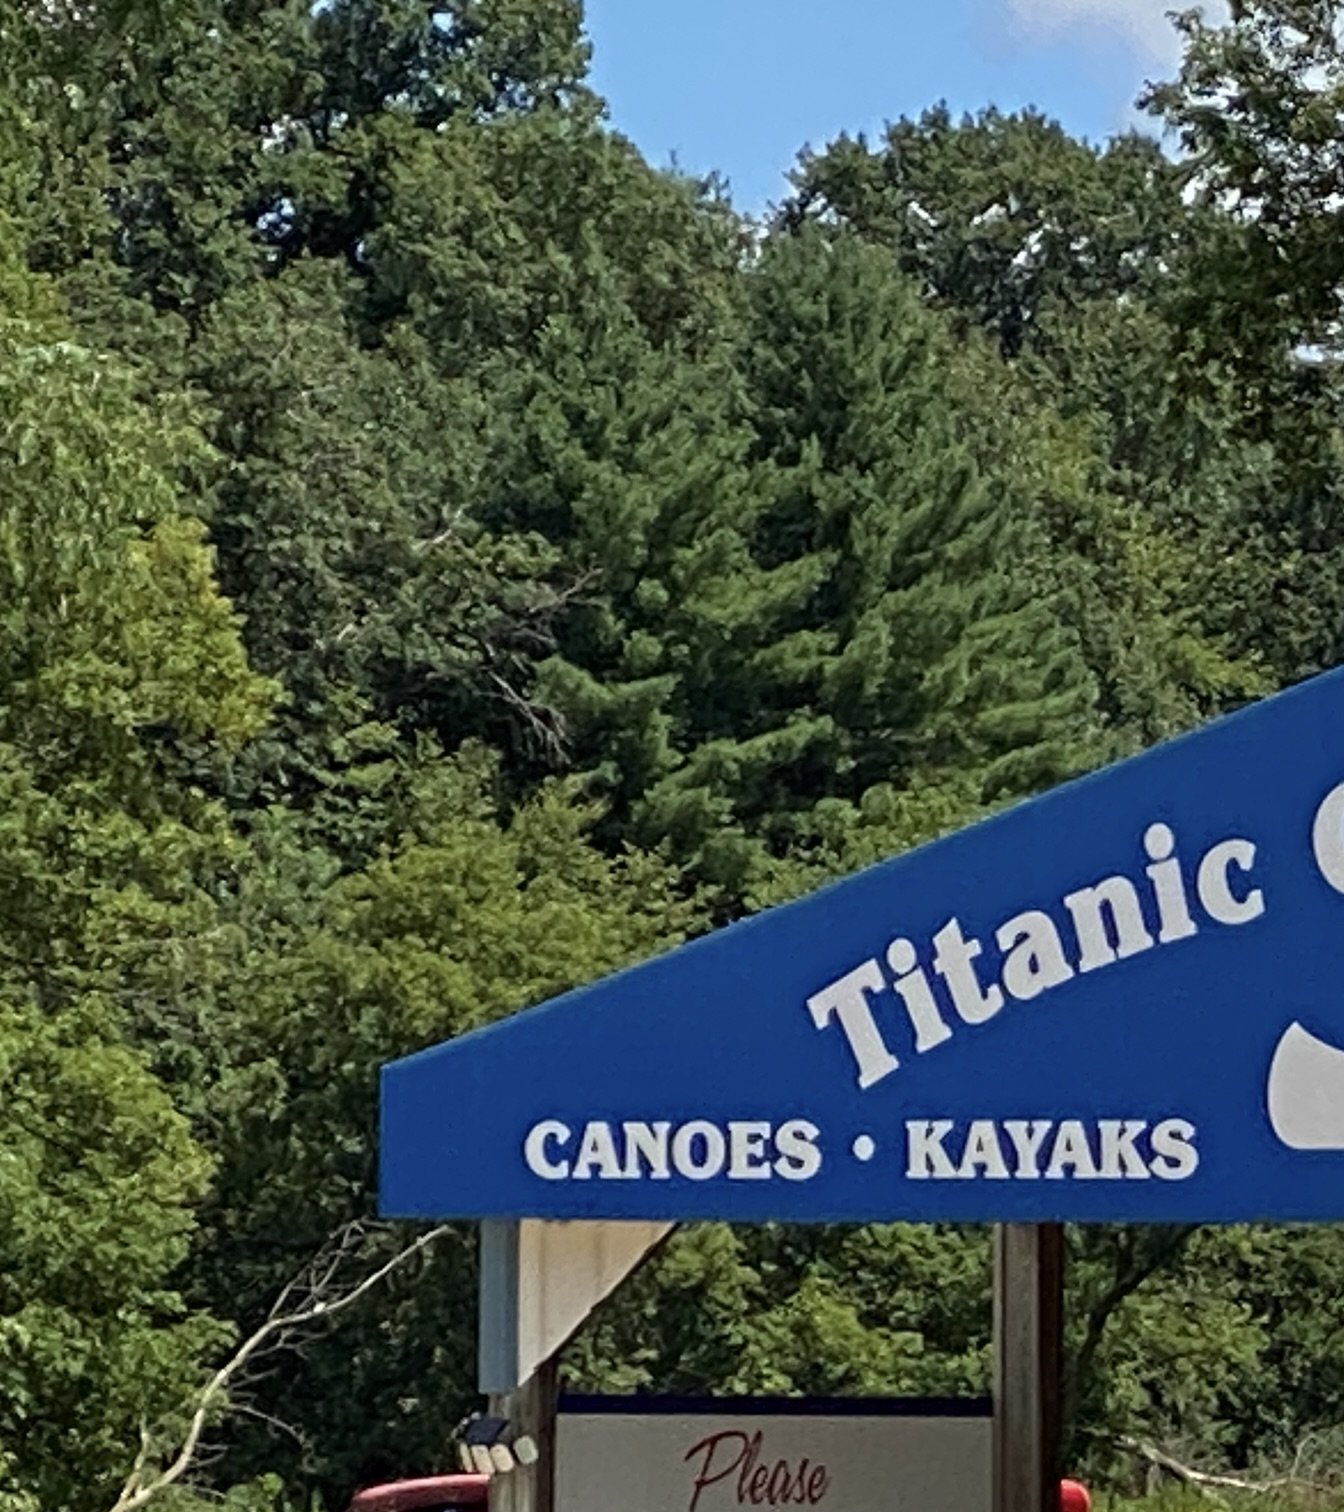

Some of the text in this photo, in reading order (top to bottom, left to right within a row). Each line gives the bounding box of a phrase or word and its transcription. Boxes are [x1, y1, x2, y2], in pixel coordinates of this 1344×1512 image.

[806, 822, 1265, 1089] Titanic
[524, 1118, 1199, 1180] CANOES KAYAKS
[685, 1430, 831, 1512] Please
